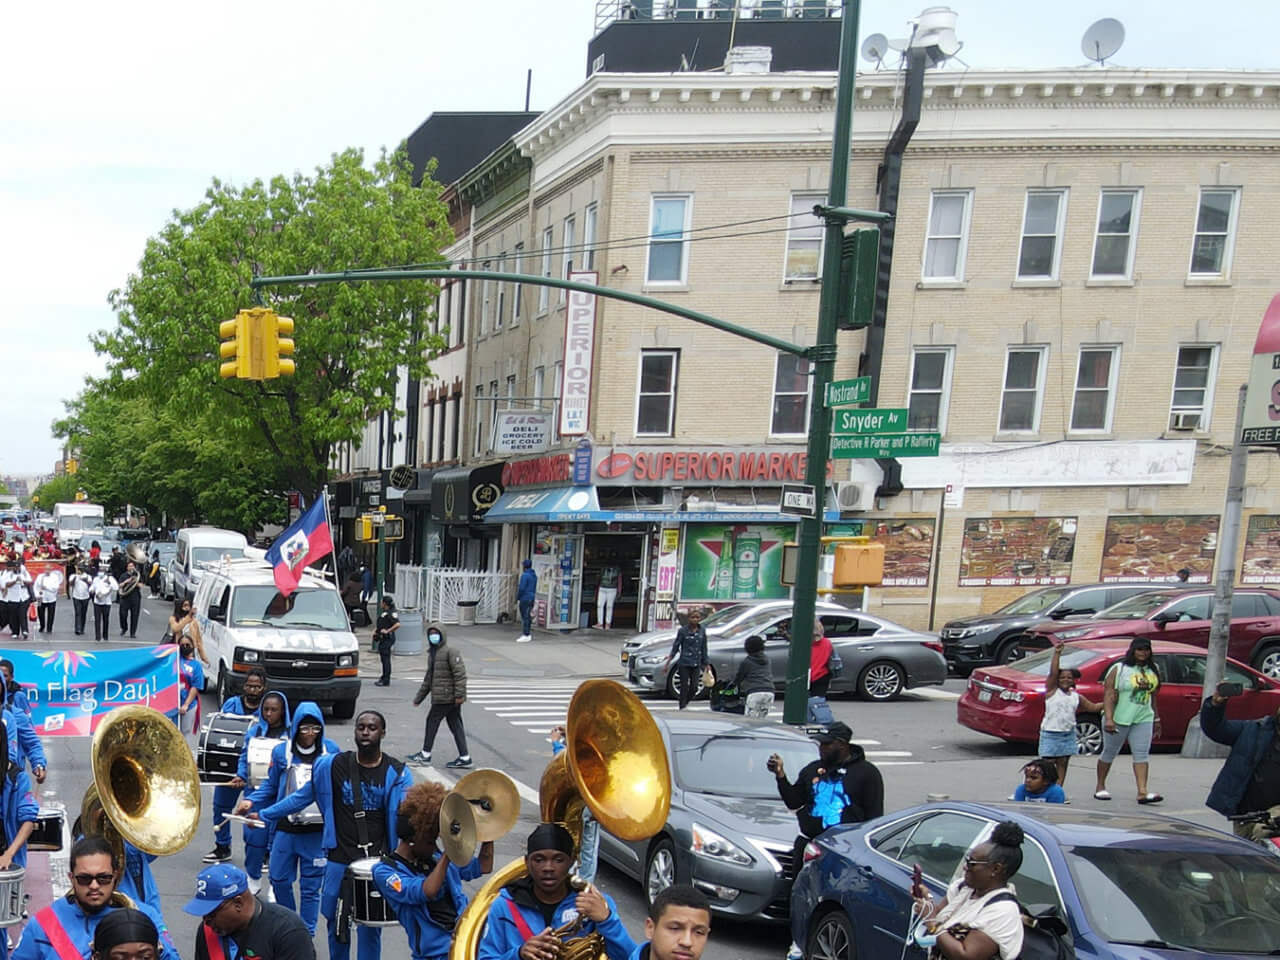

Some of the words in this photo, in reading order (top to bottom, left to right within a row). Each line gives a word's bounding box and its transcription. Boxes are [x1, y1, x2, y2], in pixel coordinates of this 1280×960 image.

[830, 384, 859, 403] Nostrand
[841, 412, 884, 433] Snyder
[888, 412, 899, 424] Av
[832, 437, 862, 449] Detective
[871, 436, 891, 448] Parker
[892, 436, 904, 447] and
[911, 435, 937, 449] Rafferty
[1244, 430, 1272, 443] FREE
[633, 452, 736, 481] SUPERIOR
[787, 493, 801, 506] ONE
[658, 566, 677, 592] EBT
[47, 673, 98, 713] Flag
[103, 674, 158, 709] Day!
